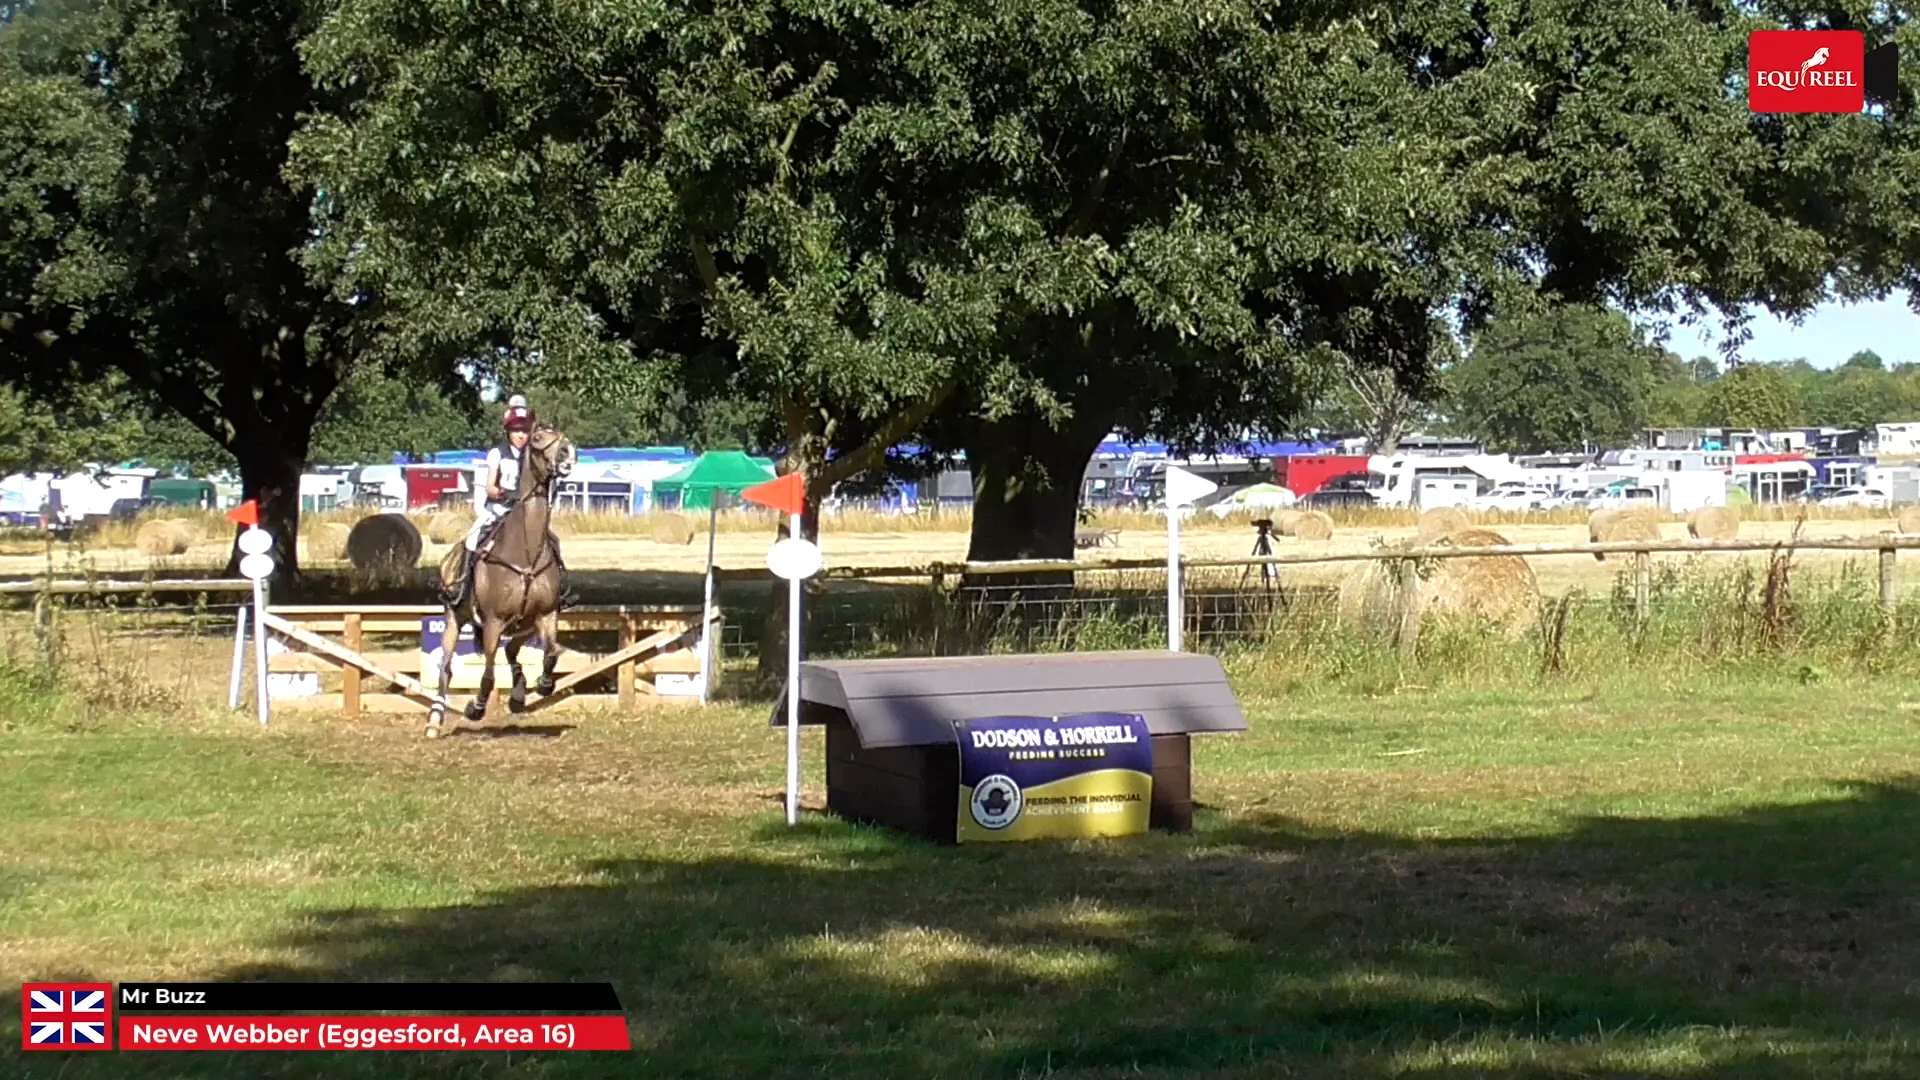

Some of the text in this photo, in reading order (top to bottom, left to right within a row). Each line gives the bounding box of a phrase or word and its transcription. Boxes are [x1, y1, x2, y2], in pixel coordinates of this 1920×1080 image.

[971, 725, 1138, 748] DODSON & HORRELL
[1008, 747, 1105, 760] FEEDING SUCCESS
[1025, 793, 1142, 806] FEEDING THE INDIVIDUAL
[1025, 803, 1089, 816] ACHIEVEMENT
